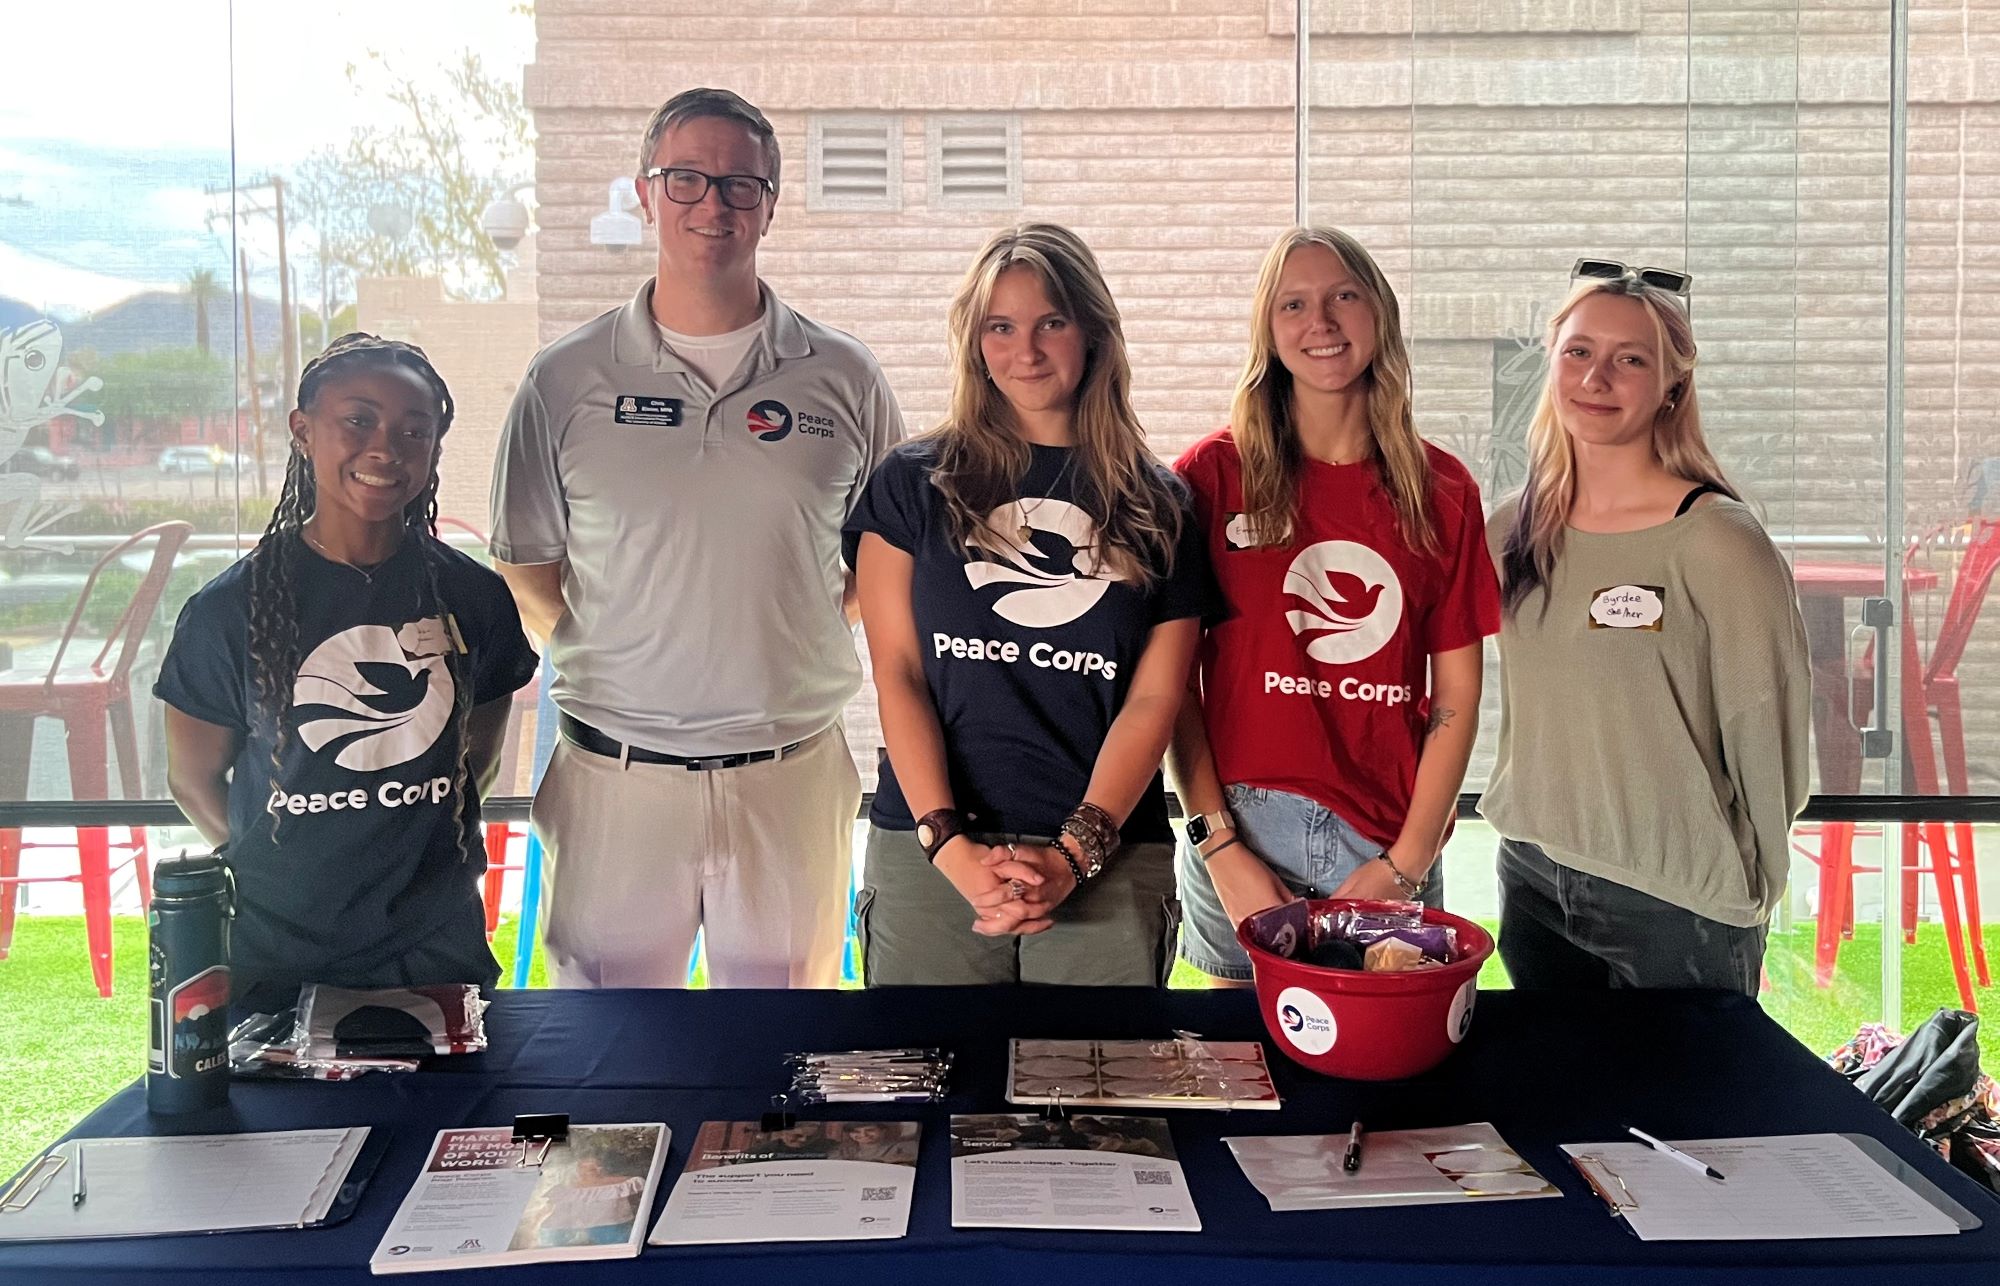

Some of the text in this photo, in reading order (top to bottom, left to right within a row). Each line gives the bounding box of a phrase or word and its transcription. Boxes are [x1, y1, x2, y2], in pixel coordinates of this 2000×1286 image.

[798, 411, 834, 427] Peace
[798, 423, 834, 438] Corps
[933, 632, 1118, 681] Peace Corps
[1264, 671, 1411, 707] Peace Corps
[377, 776, 451, 808] Corp
[1305, 1015, 1329, 1024] Peace
[1306, 1023, 1330, 1032] Corps
[450, 1134, 501, 1143] MAKE
[448, 1142, 536, 1151] THE MOST
[961, 1140, 1012, 1148] Service
[443, 1151, 471, 1160] OF
[702, 1152, 757, 1160] Benefits
[440, 1159, 508, 1168] WORLD
